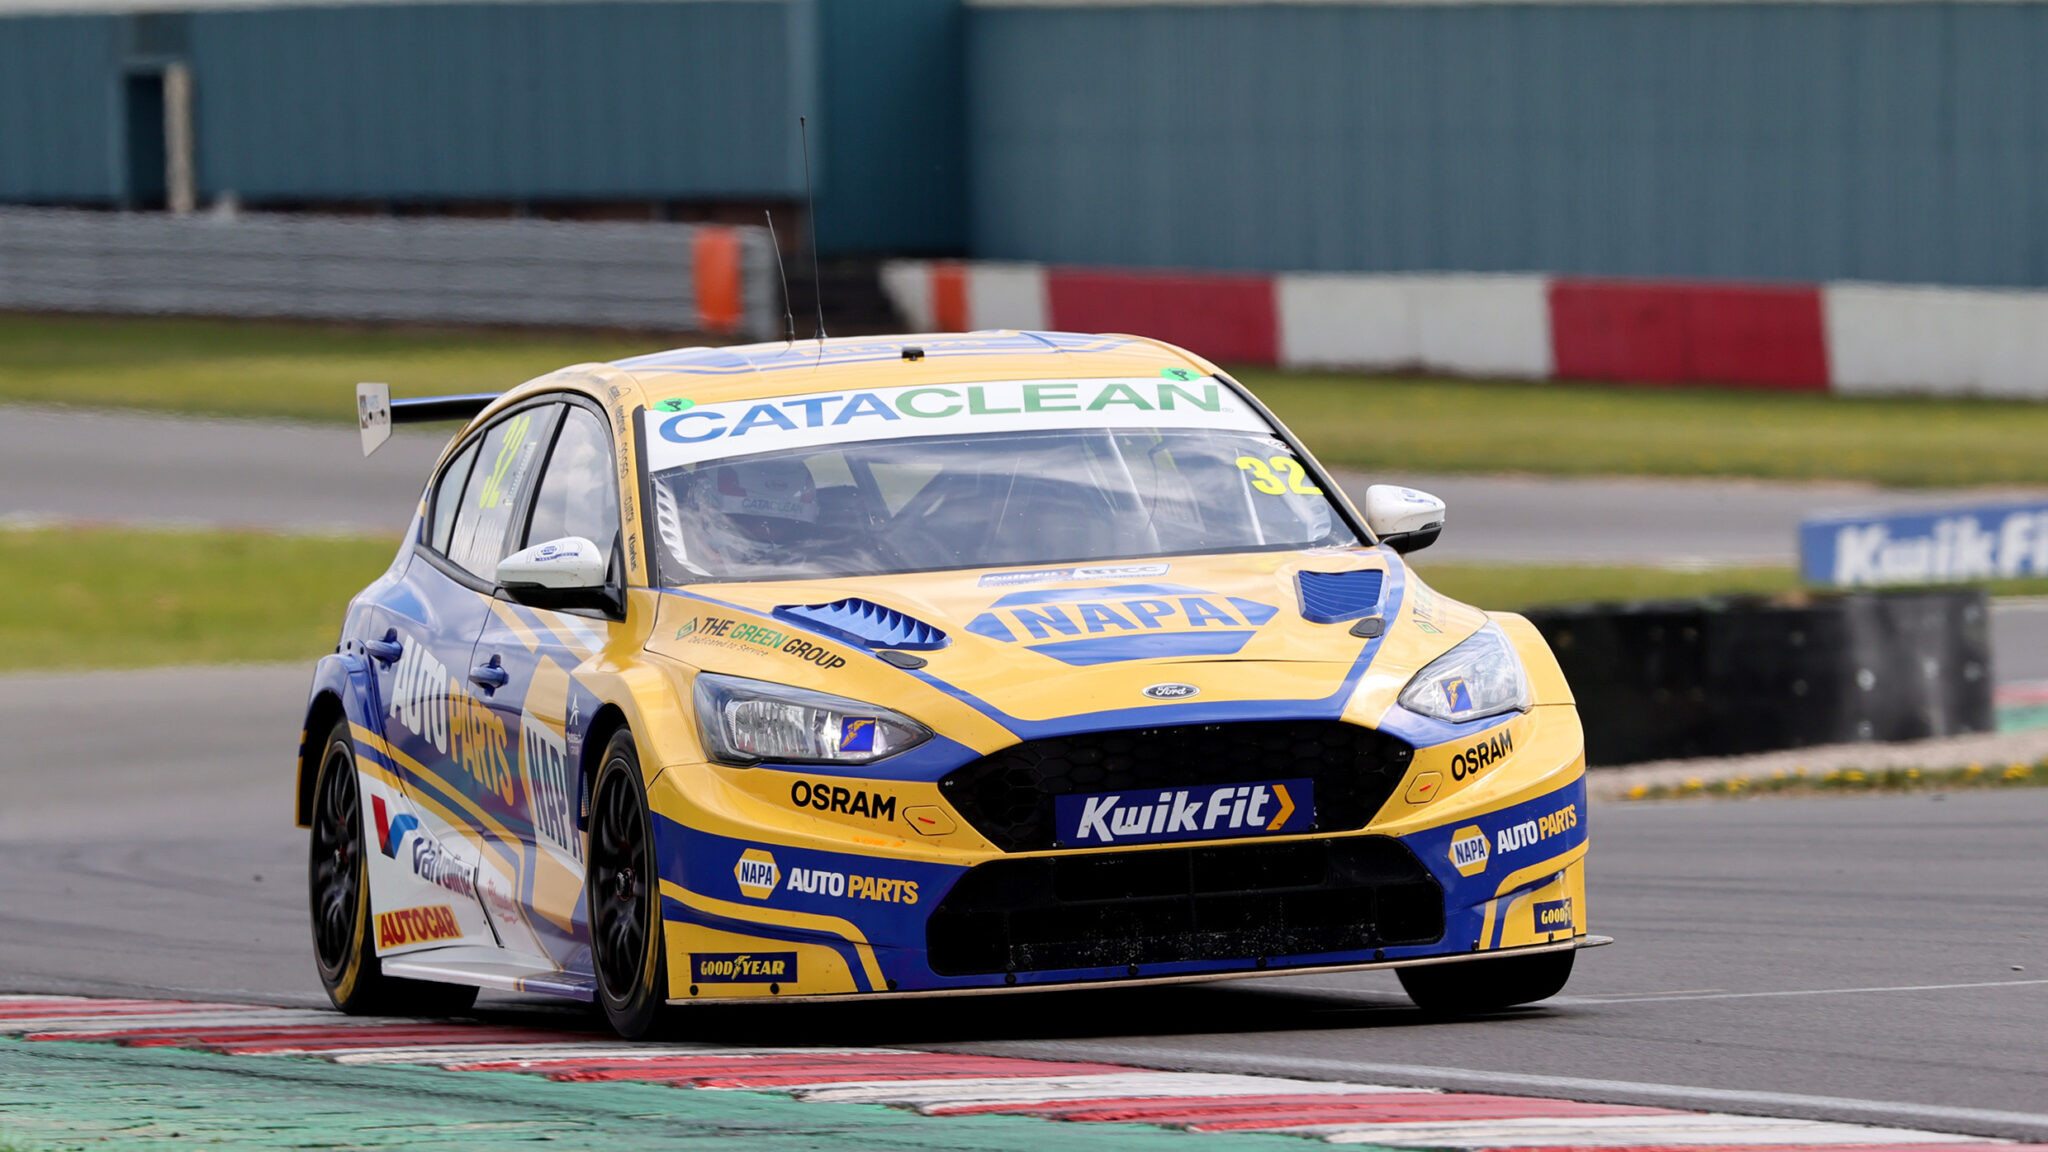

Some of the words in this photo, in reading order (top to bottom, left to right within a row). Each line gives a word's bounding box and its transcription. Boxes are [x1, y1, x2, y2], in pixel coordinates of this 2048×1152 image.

[659, 383, 1220, 443] CATACLEAN
[479, 415, 530, 508] 32
[1235, 456, 1324, 495] 32
[1011, 597, 1241, 640] NAPA
[699, 617, 735, 637] THE
[730, 623, 789, 649] GREEN
[782, 638, 846, 669] GROUP
[1155, 685, 1188, 697] Ford
[389, 634, 447, 755] AUTO
[448, 676, 514, 807] PARTS
[1451, 728, 1513, 781] OSRAM
[791, 780, 897, 822] OSRAM
[1454, 838, 1486, 865] NAPA
[1497, 820, 1538, 854] AUTO
[1538, 804, 1576, 840] PARTS
[741, 861, 773, 886] NAPA
[787, 867, 844, 896] AUTO
[848, 875, 919, 904] PARTS
[380, 906, 459, 948] AUTOCAR
